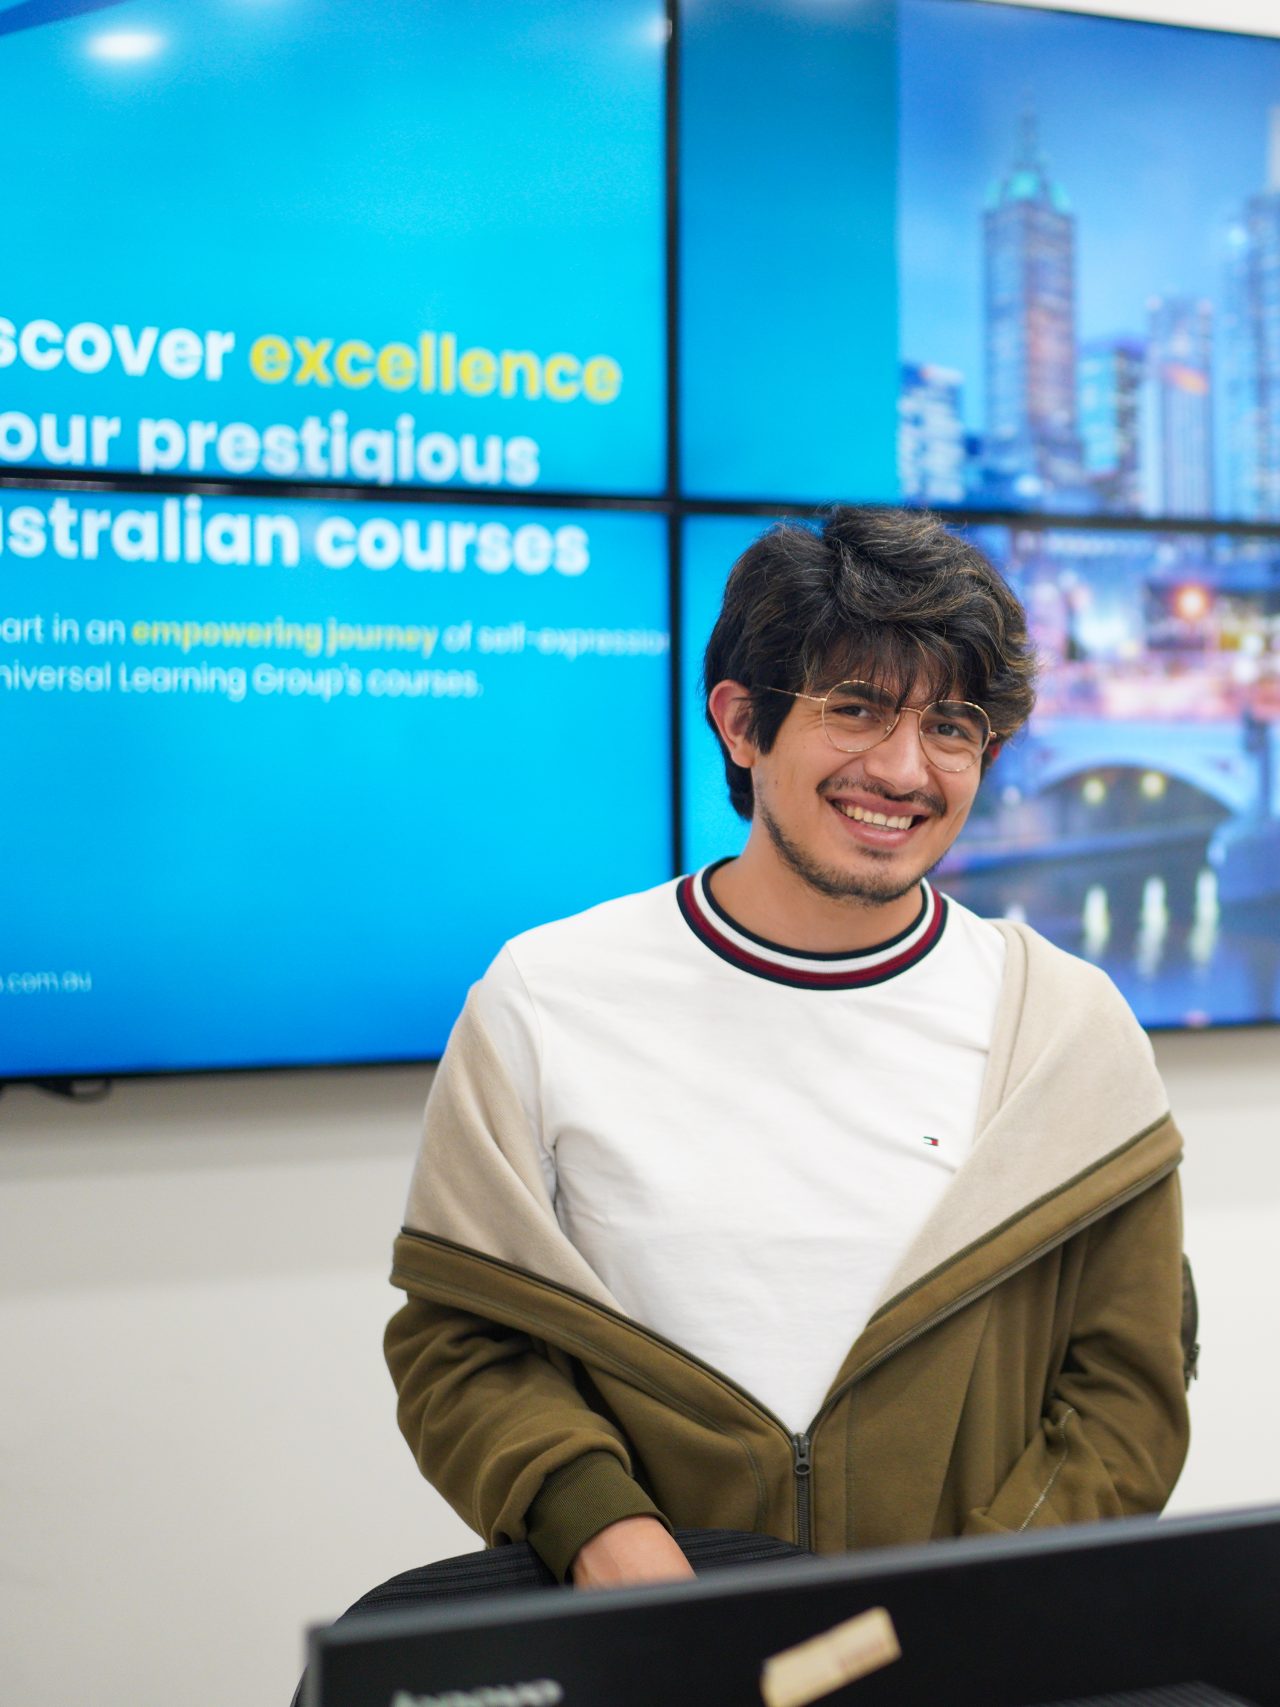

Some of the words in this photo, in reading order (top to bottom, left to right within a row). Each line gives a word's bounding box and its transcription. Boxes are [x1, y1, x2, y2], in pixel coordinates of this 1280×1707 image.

[249, 331, 622, 404] excellence
[0, 410, 121, 467] our
[0, 494, 300, 566] stralian
[314, 514, 590, 576] courses
[0, 614, 44, 644] art
[53, 612, 79, 645] in
[85, 617, 126, 646] an
[131, 615, 323, 659] empowering
[325, 616, 439, 660] journey
[441, 619, 473, 654] of
[118, 660, 247, 702] Learning
[252, 662, 363, 703] Group's
[0, 971, 92, 995] .com.au
